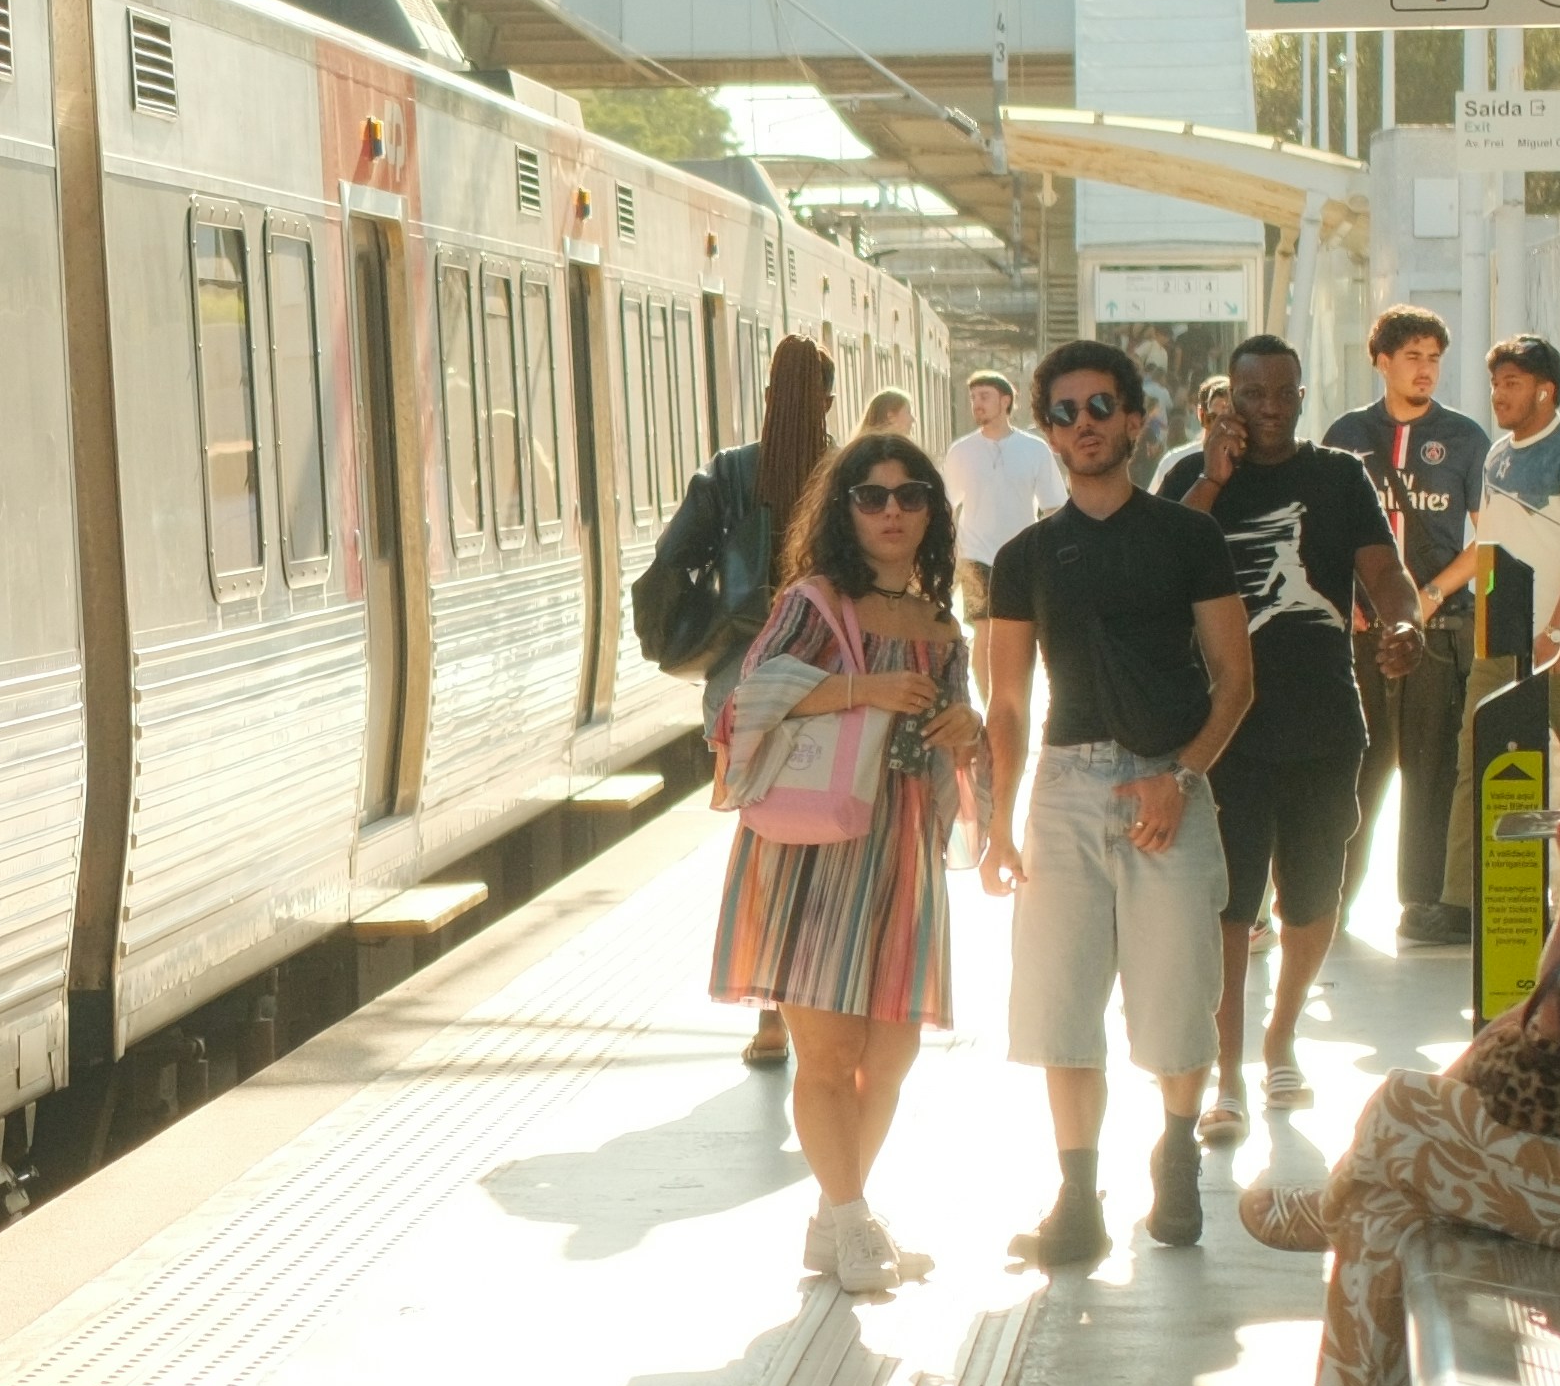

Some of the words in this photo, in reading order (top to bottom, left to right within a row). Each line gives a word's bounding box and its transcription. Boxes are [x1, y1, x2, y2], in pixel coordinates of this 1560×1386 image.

[1464, 121, 1491, 134] Exit
[1484, 138, 1505, 148] Frei
[1517, 138, 1553, 150] Miguel
[1163, 281, 1170, 294] 2
[1205, 281, 1212, 294] 4
